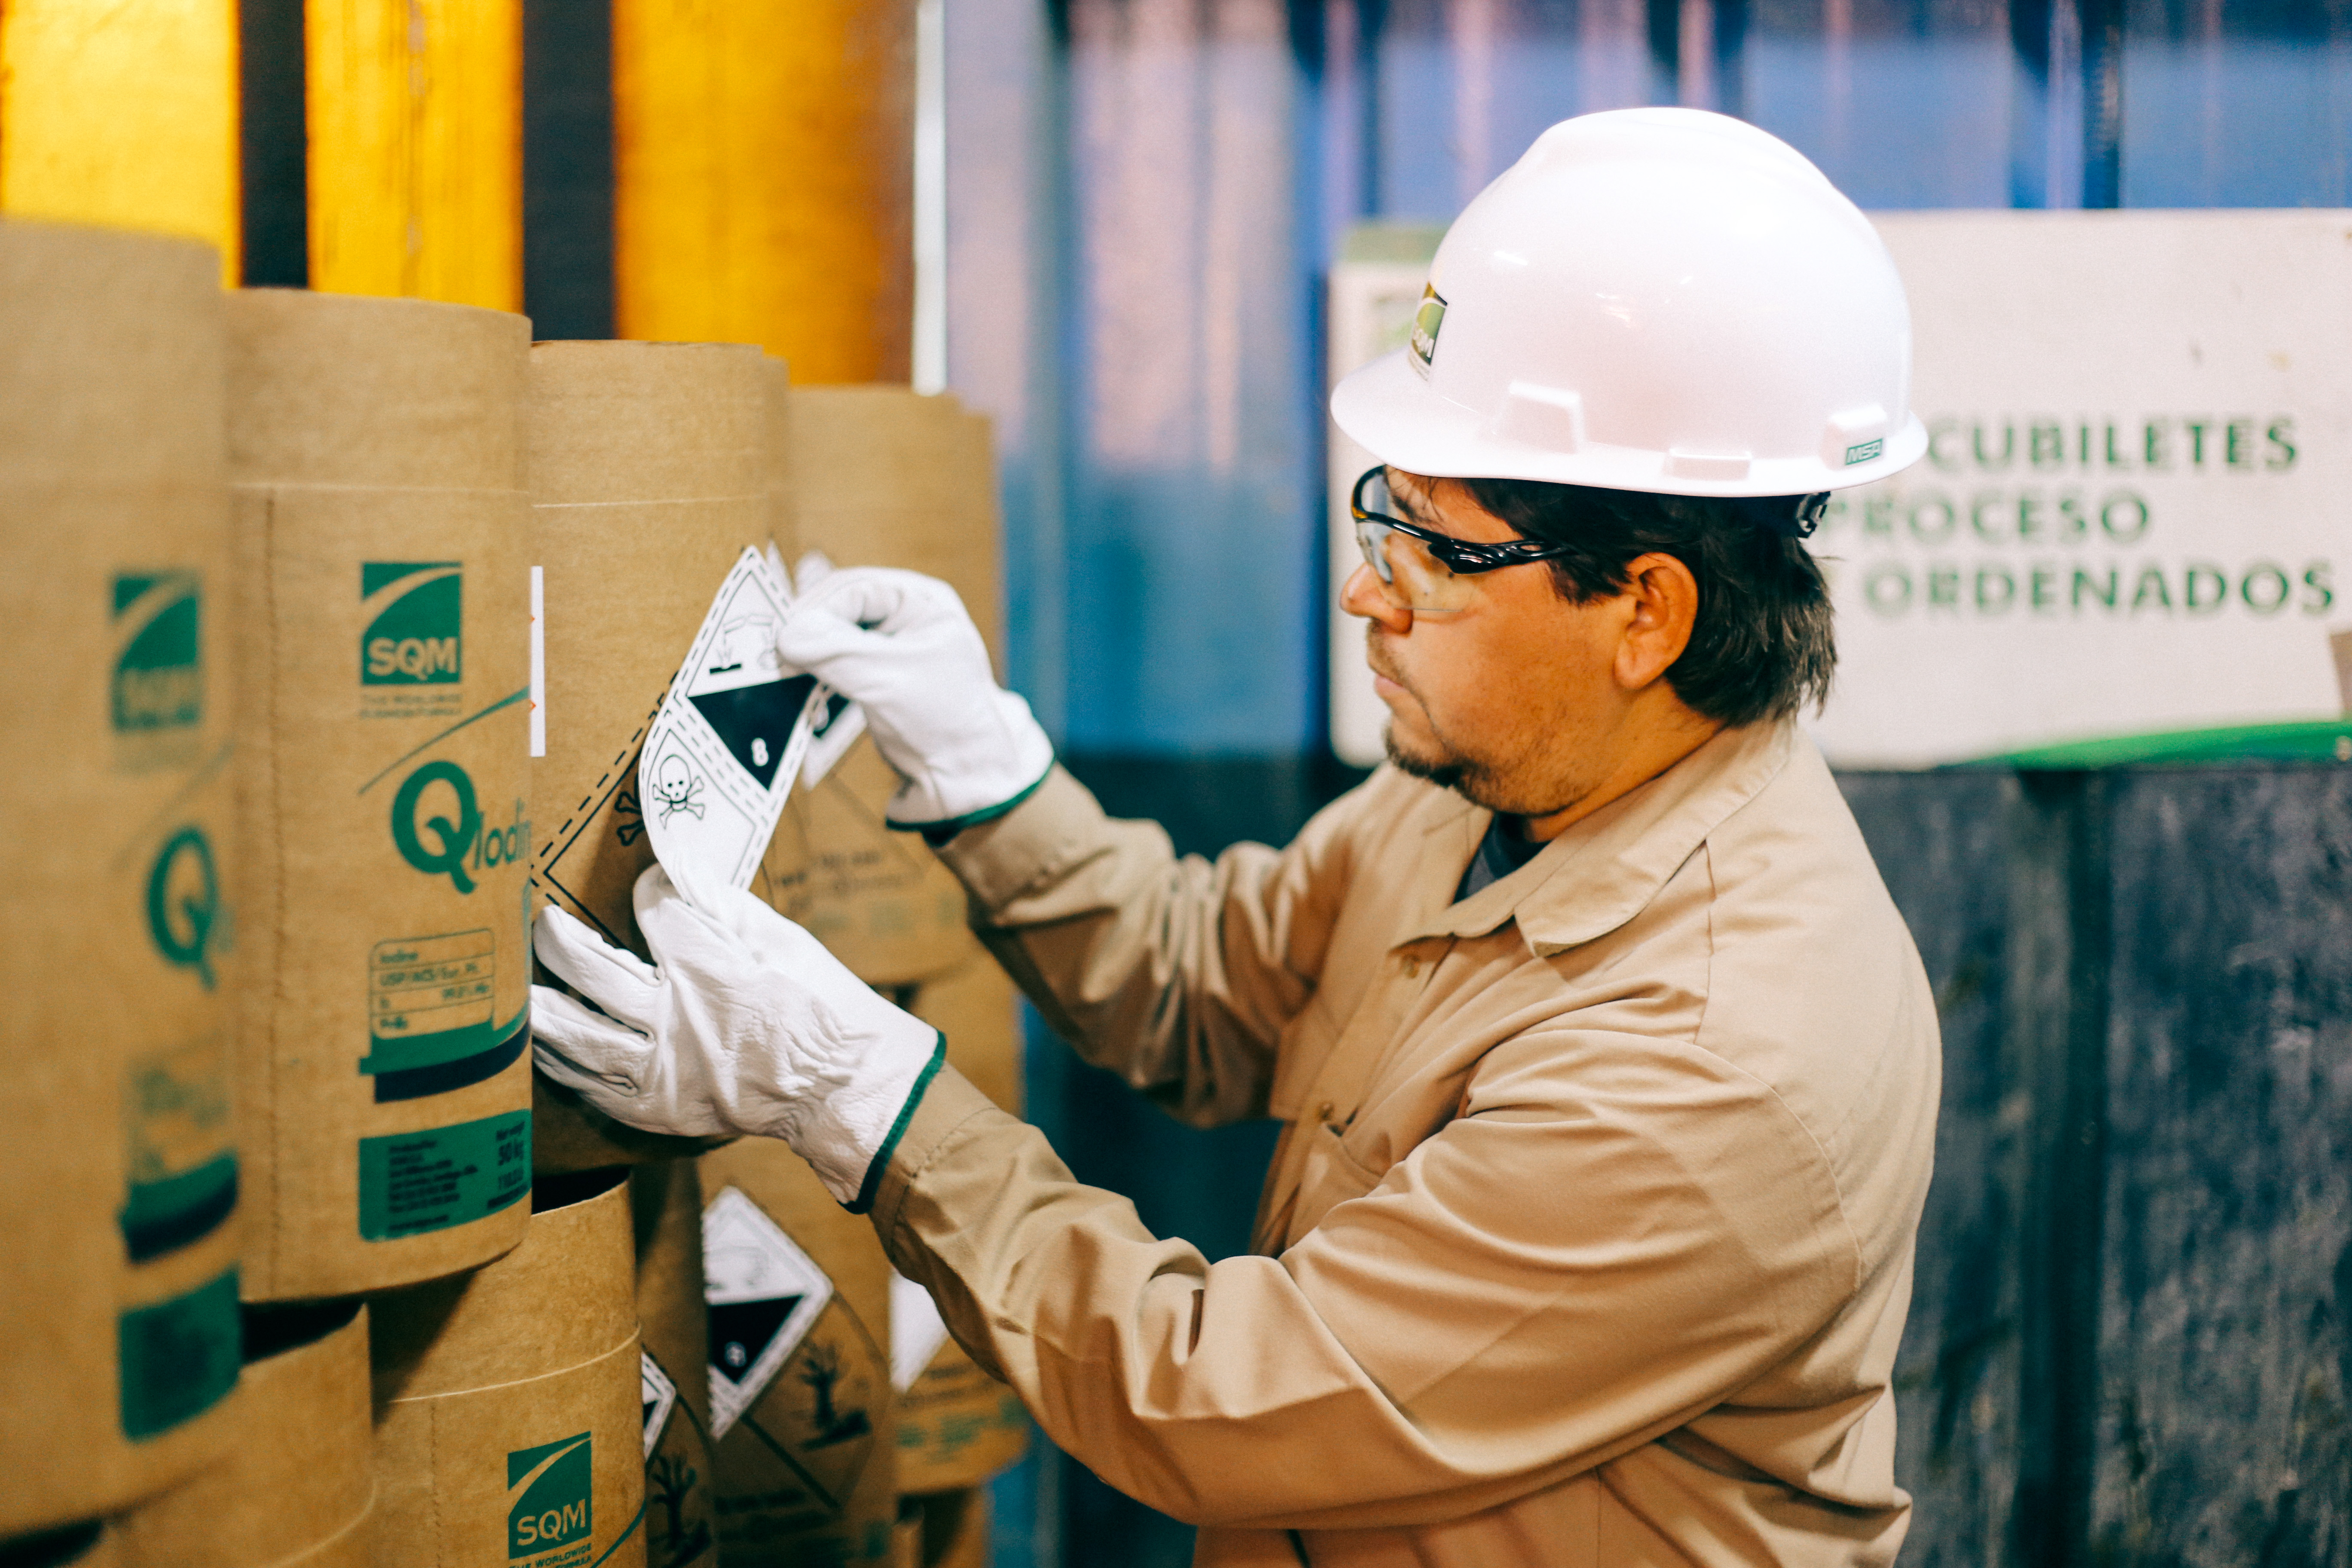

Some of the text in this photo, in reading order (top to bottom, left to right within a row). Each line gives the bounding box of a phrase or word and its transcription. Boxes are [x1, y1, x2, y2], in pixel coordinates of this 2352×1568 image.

[1847, 441, 1881, 463] MSA
[1929, 419, 2297, 470] CUBILETES
[1822, 489, 2148, 543] PROCESO
[1866, 562, 2334, 616] ORDENADOS
[368, 636, 457, 680] SQM
[751, 737, 769, 767] 8
[517, 1498, 586, 1546] SQM
